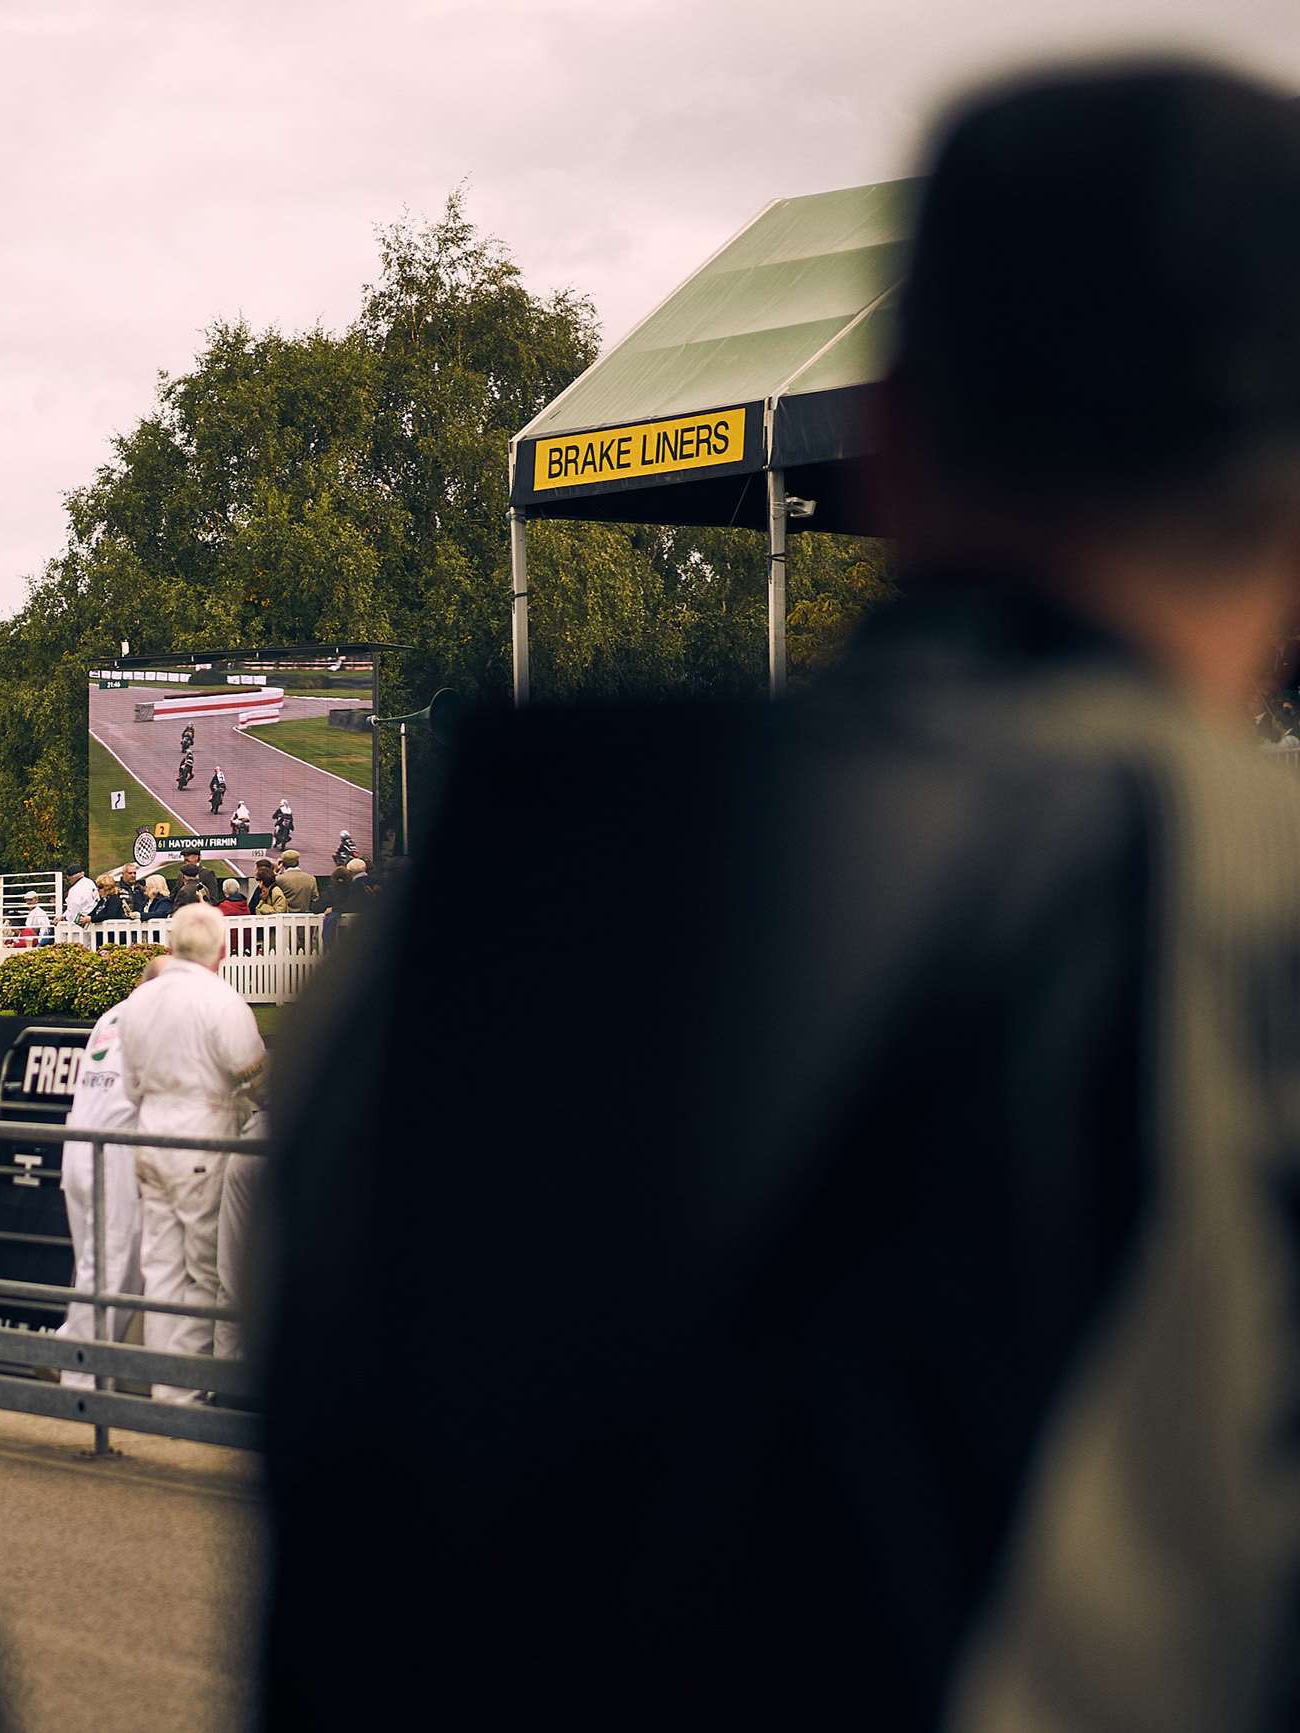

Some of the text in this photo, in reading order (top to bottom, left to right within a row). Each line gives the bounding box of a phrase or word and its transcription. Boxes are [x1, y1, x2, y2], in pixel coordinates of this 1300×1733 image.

[547, 420, 730, 479] BRAKE LINERS
[168, 839, 203, 848] HAYDON
[209, 838, 237, 847] FIRMIN
